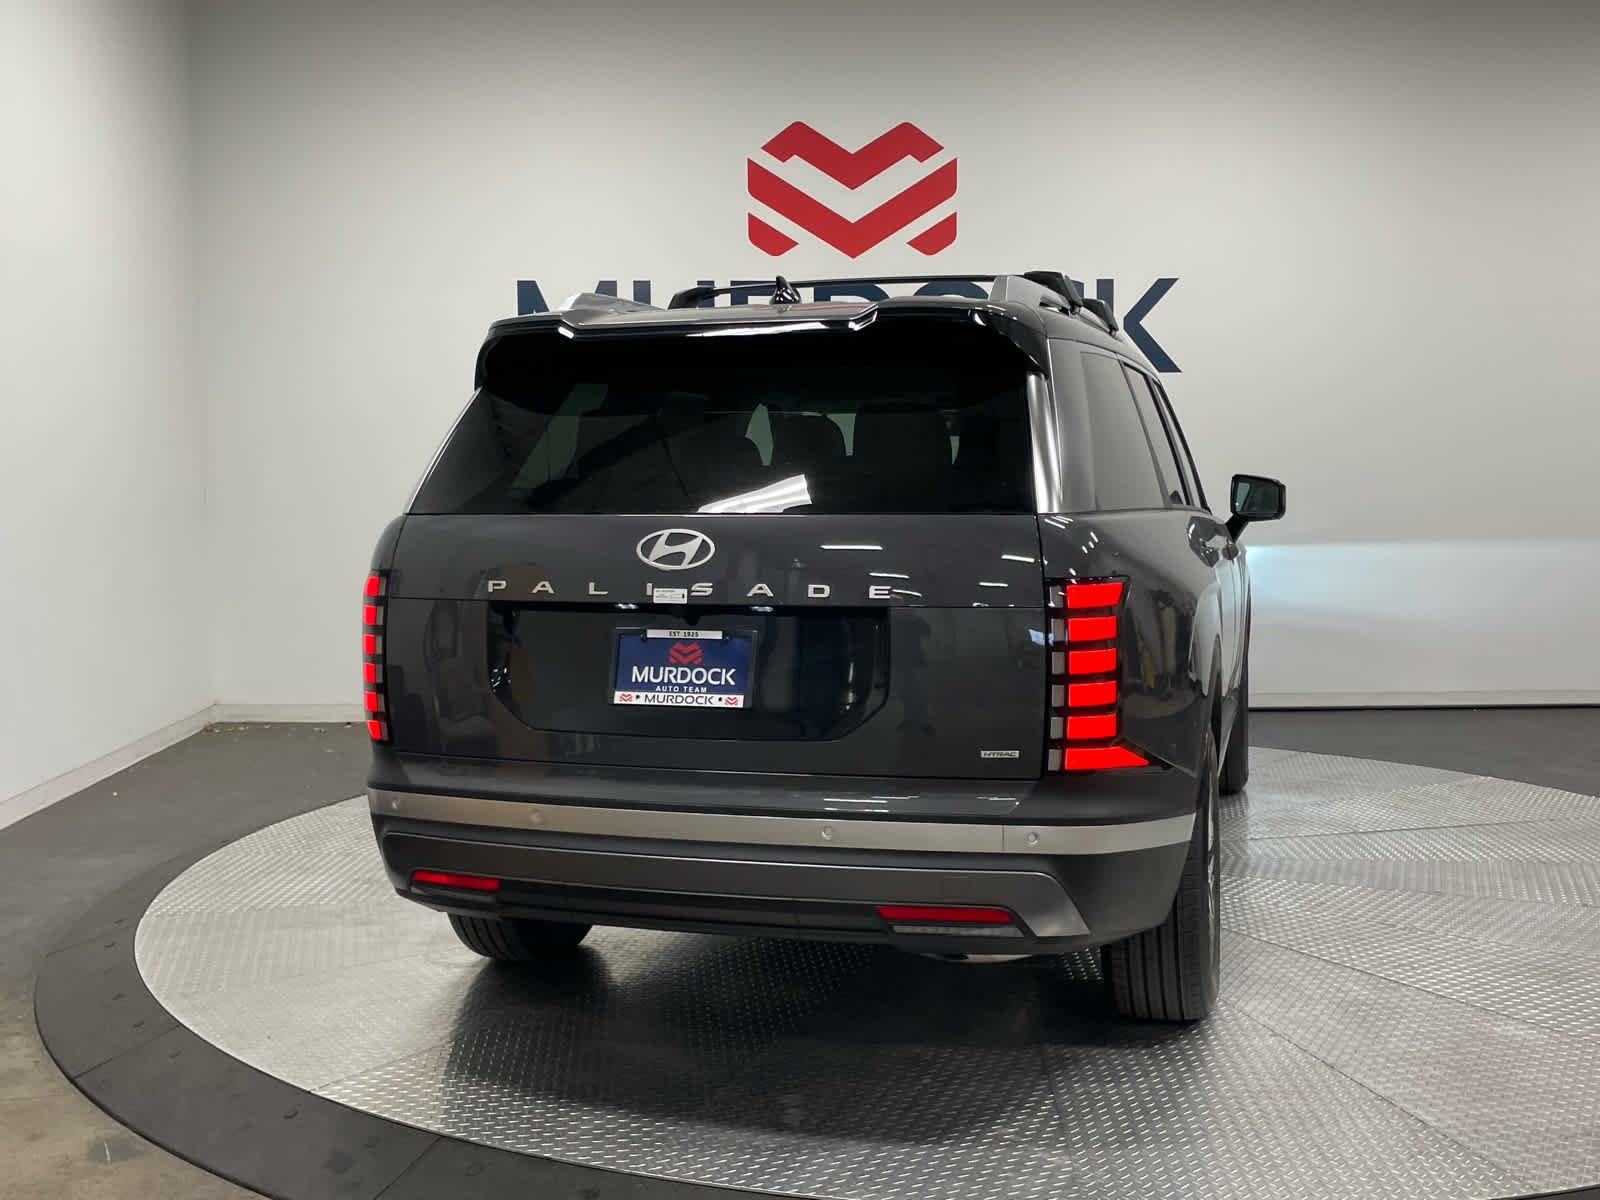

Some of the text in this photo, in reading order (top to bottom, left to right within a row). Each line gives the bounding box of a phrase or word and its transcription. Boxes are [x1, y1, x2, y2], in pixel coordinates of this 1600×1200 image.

[487, 580, 892, 599] PALISADE
[631, 665, 737, 686] MURDOCK
[655, 685, 680, 693] AUTO
[644, 694, 714, 705] MURDOCK
